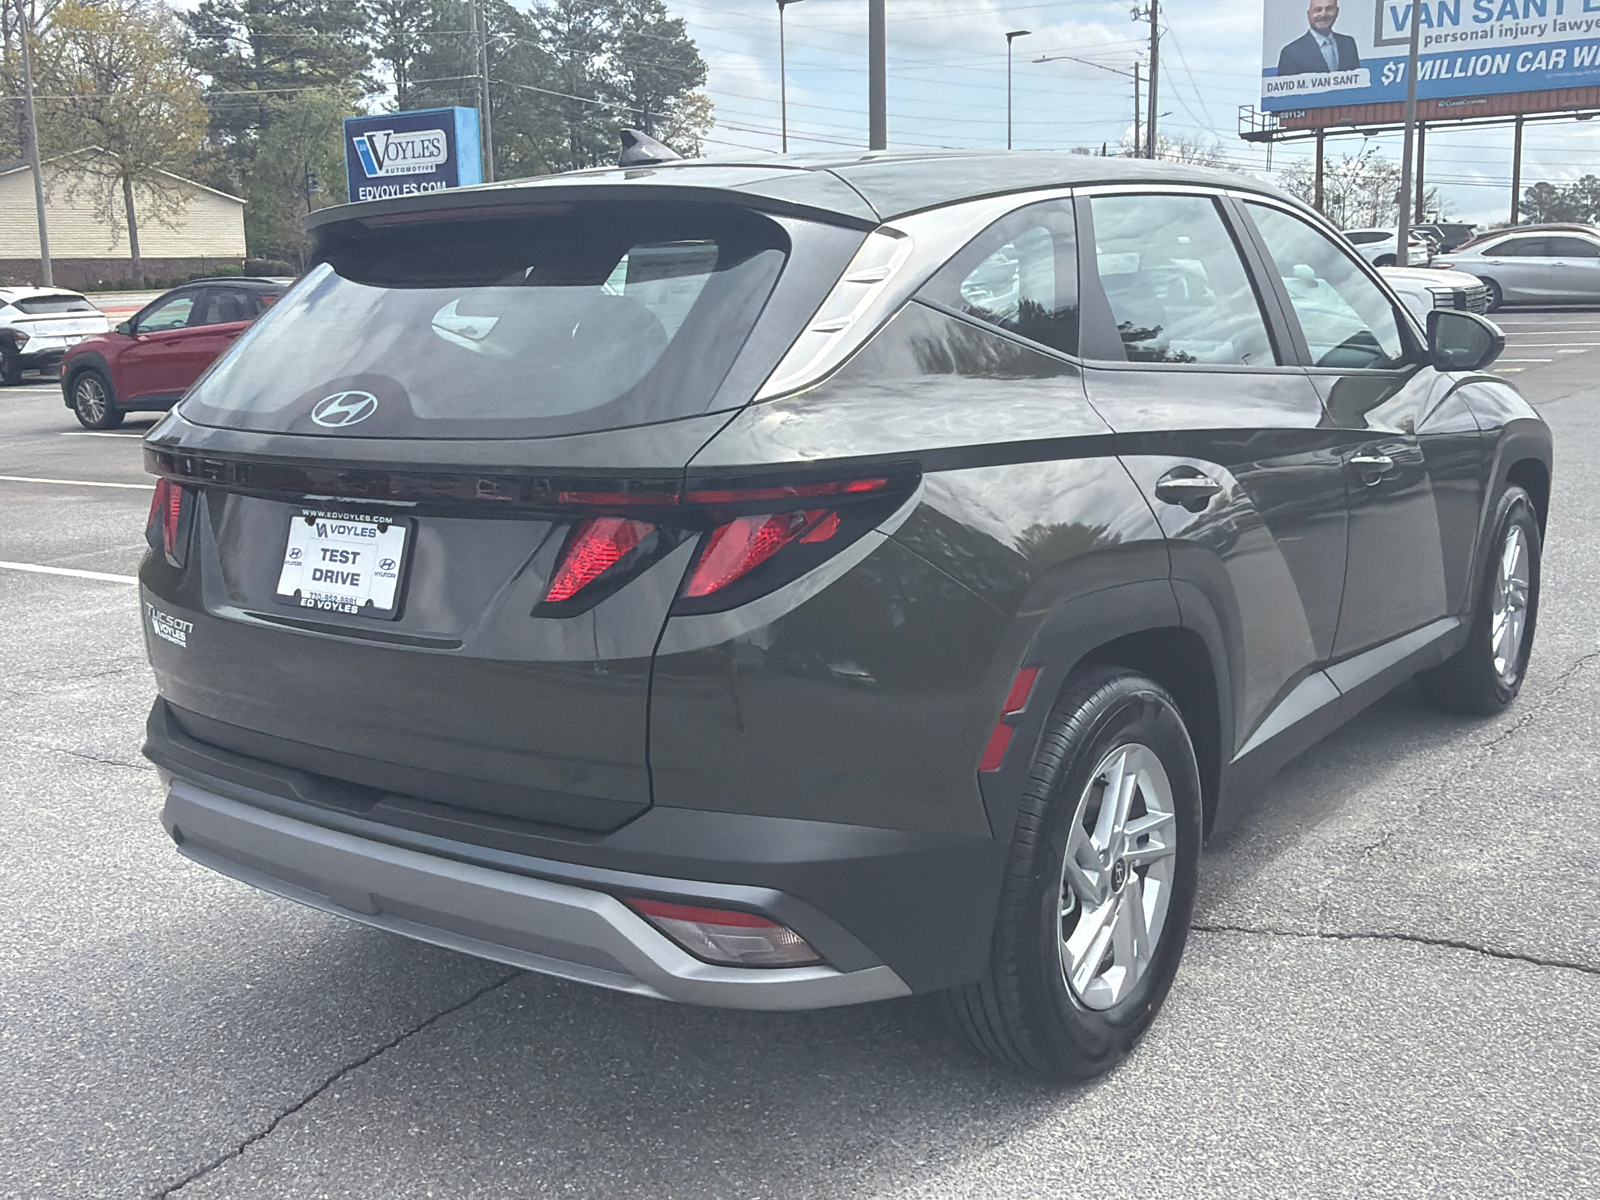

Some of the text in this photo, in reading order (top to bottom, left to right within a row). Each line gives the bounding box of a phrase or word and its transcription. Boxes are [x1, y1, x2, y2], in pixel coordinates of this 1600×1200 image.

[1390, 0, 1460, 32] VAN
[1424, 25, 1494, 48] personal
[1499, 22, 1548, 40] injury
[1381, 61, 1405, 86] $1
[1416, 53, 1511, 81] MILLION
[1516, 48, 1567, 73] CAR
[1267, 74, 1360, 92] DAVID M. VAN SANT
[365, 133, 440, 171] VOYLES
[385, 164, 434, 174] AUTOMOTIVE
[358, 181, 447, 200] EDVOYLESCOM
[302, 509, 393, 524] WWW.EDVOYLES.COM
[330, 524, 377, 538] VOYLES
[321, 548, 360, 565] TEST
[312, 568, 361, 586] DRIVE
[301, 598, 358, 614] ED VOYLES
[146, 602, 194, 633] TUCSON
